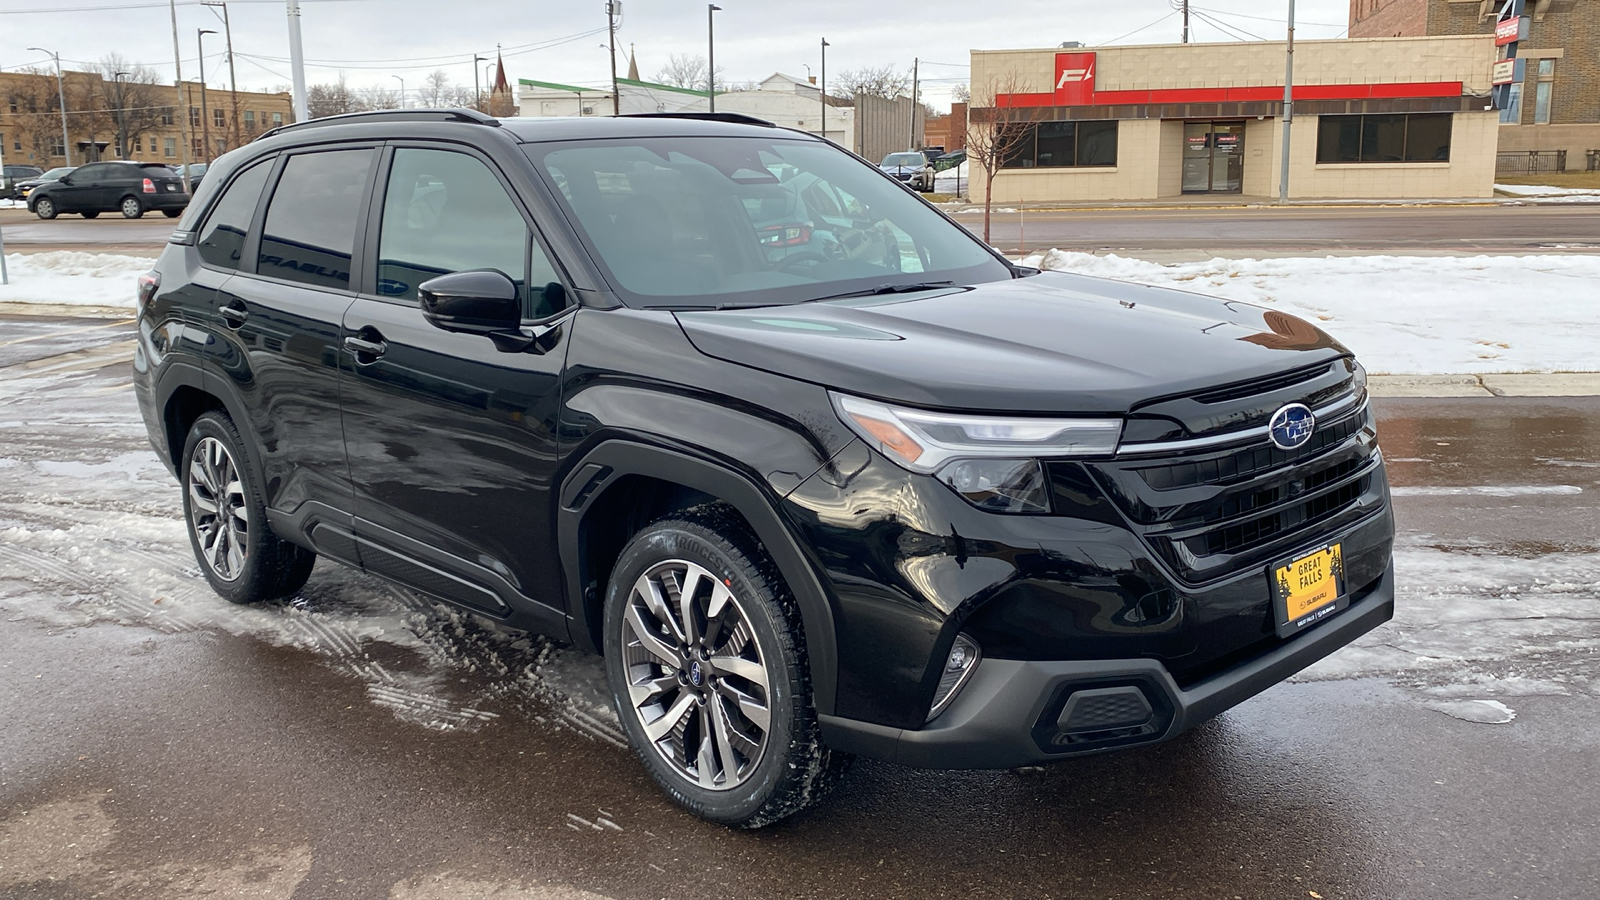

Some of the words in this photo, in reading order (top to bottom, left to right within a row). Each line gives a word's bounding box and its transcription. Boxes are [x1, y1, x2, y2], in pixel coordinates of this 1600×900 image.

[1298, 556, 1321, 576] GREAT
[1299, 568, 1323, 590] FALLS
[1306, 591, 1327, 606] SUBARU
